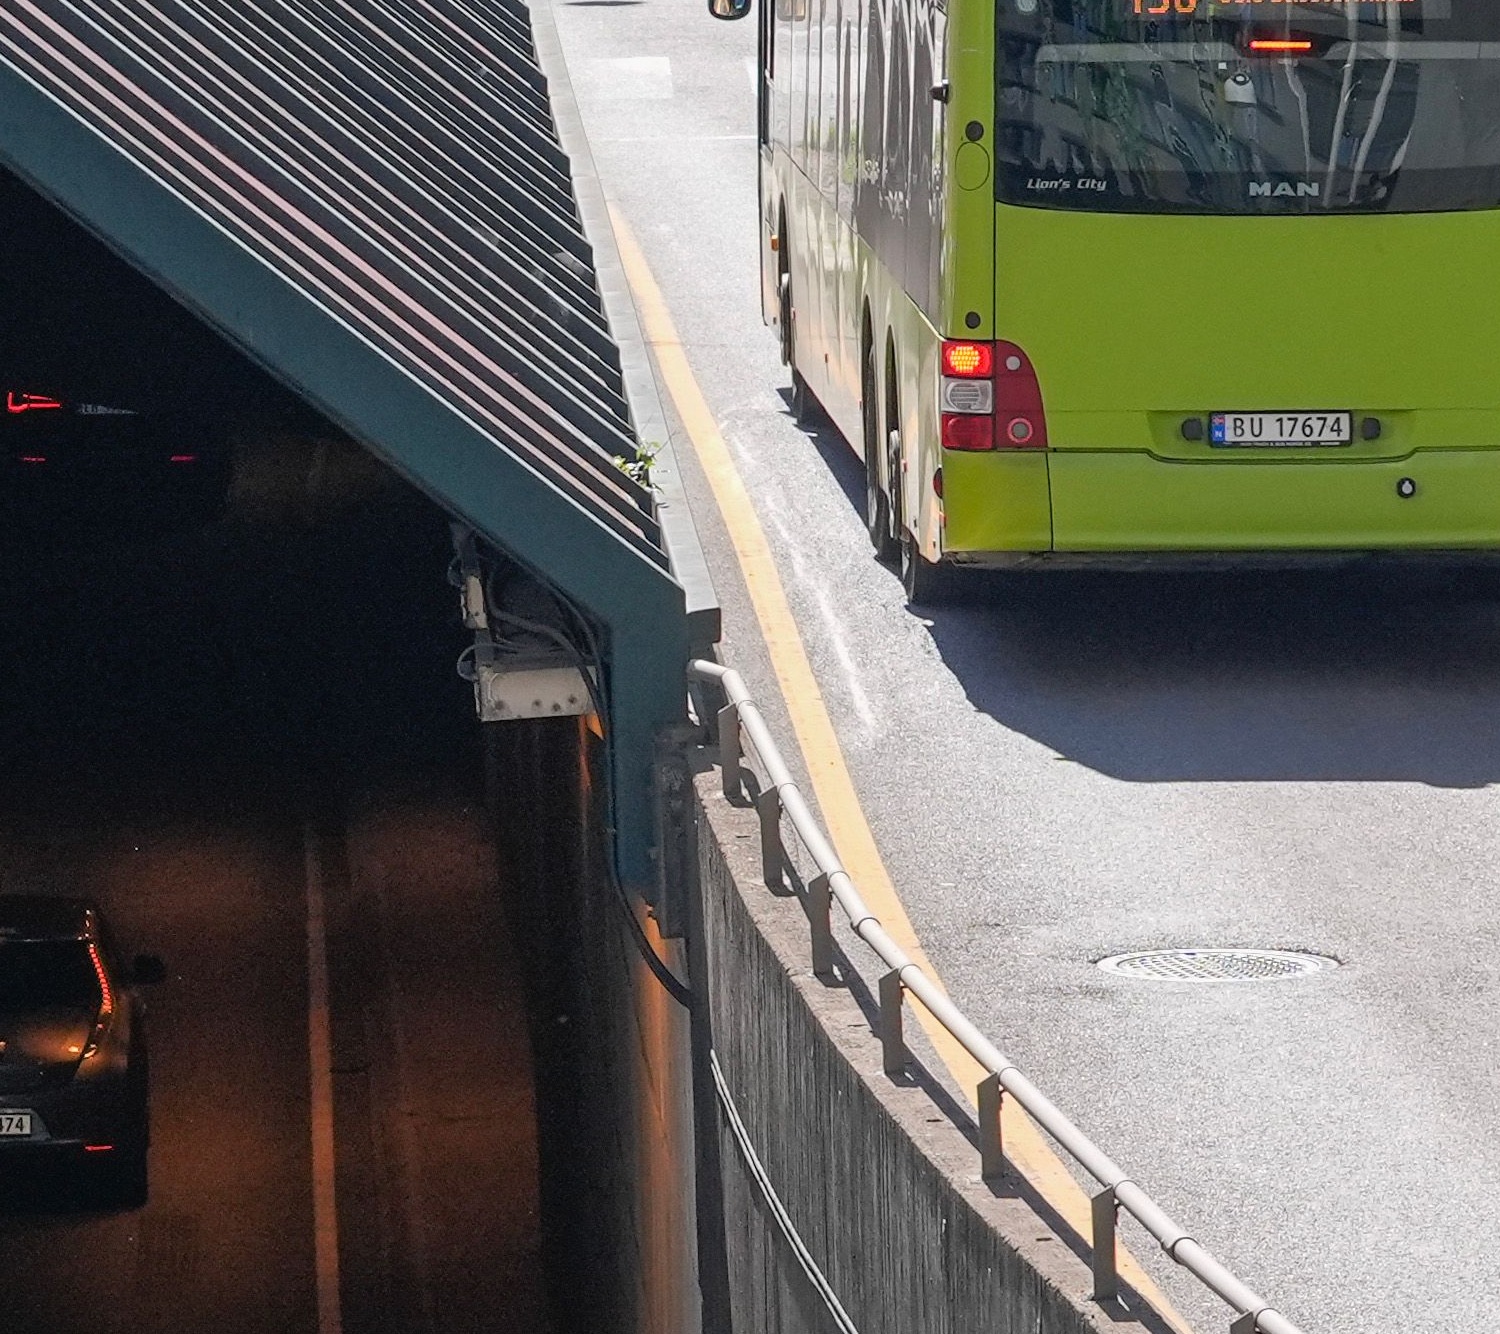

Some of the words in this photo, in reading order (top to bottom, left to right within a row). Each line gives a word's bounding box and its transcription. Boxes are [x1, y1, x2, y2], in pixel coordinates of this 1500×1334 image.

[1027, 178, 1071, 190] Lion's
[1077, 178, 1107, 192] City
[1249, 182, 1319, 197] MAN
[1233, 418, 1263, 438] BU
[1275, 417, 1343, 438] 17674
